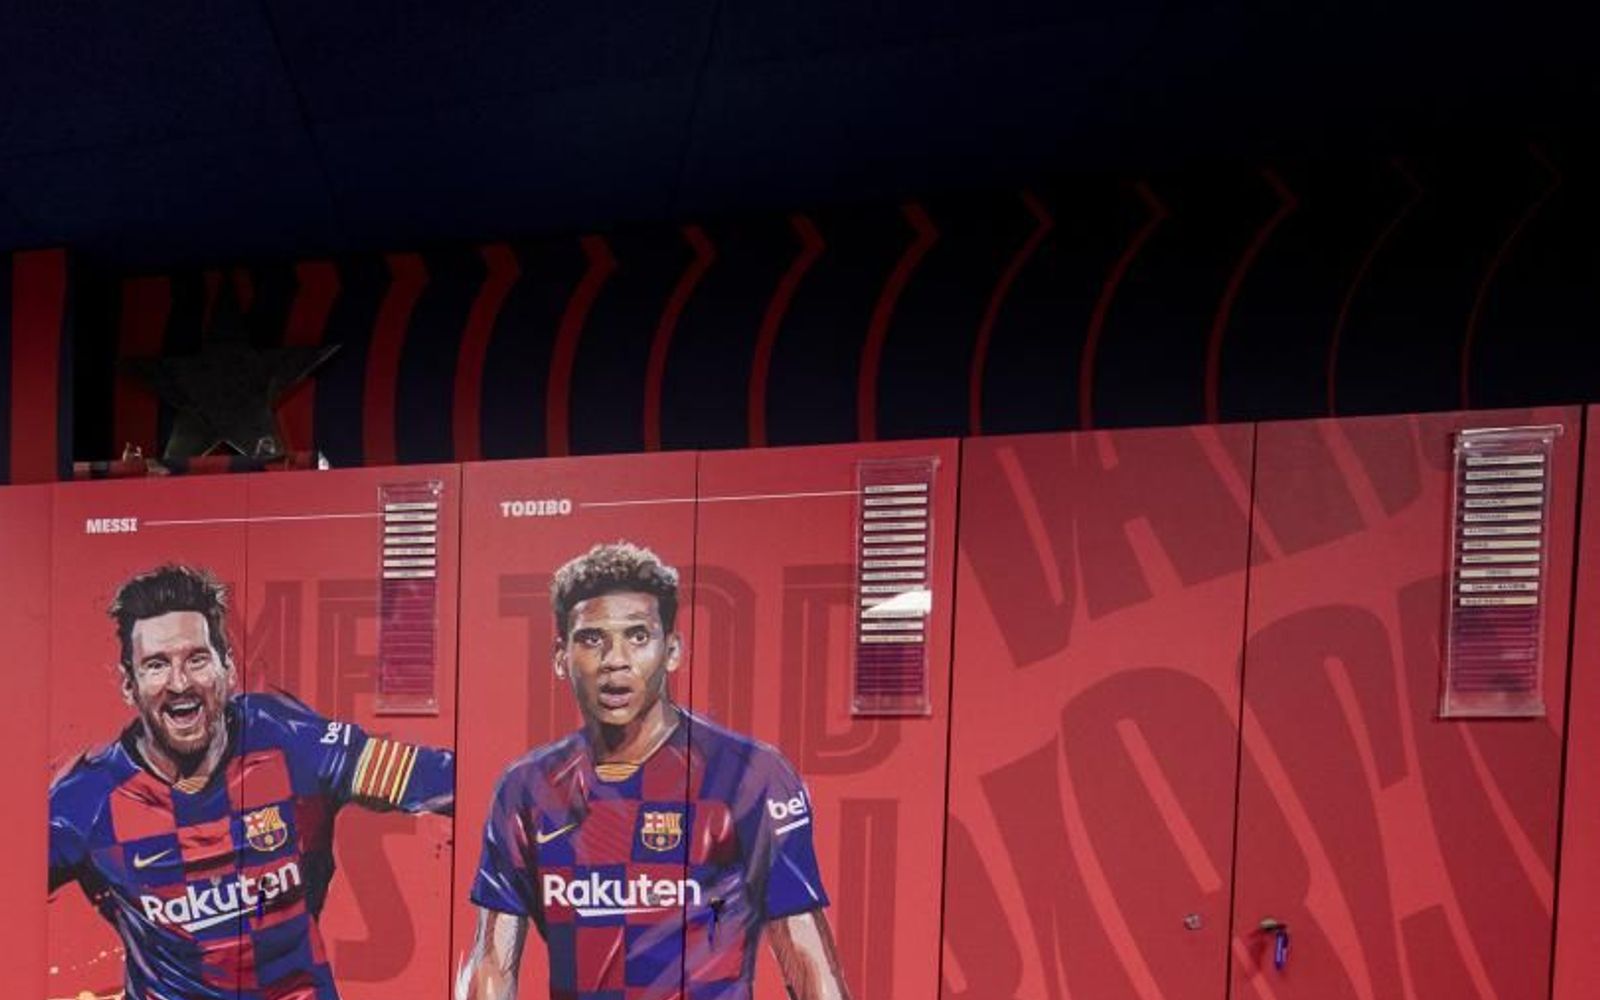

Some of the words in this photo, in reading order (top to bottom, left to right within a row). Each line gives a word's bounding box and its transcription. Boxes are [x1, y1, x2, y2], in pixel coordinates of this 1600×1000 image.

[500, 499, 572, 518] TODIBO
[86, 518, 138, 534] MESSI
[140, 861, 301, 926] Rakuten
[543, 871, 701, 909] Rakuten
